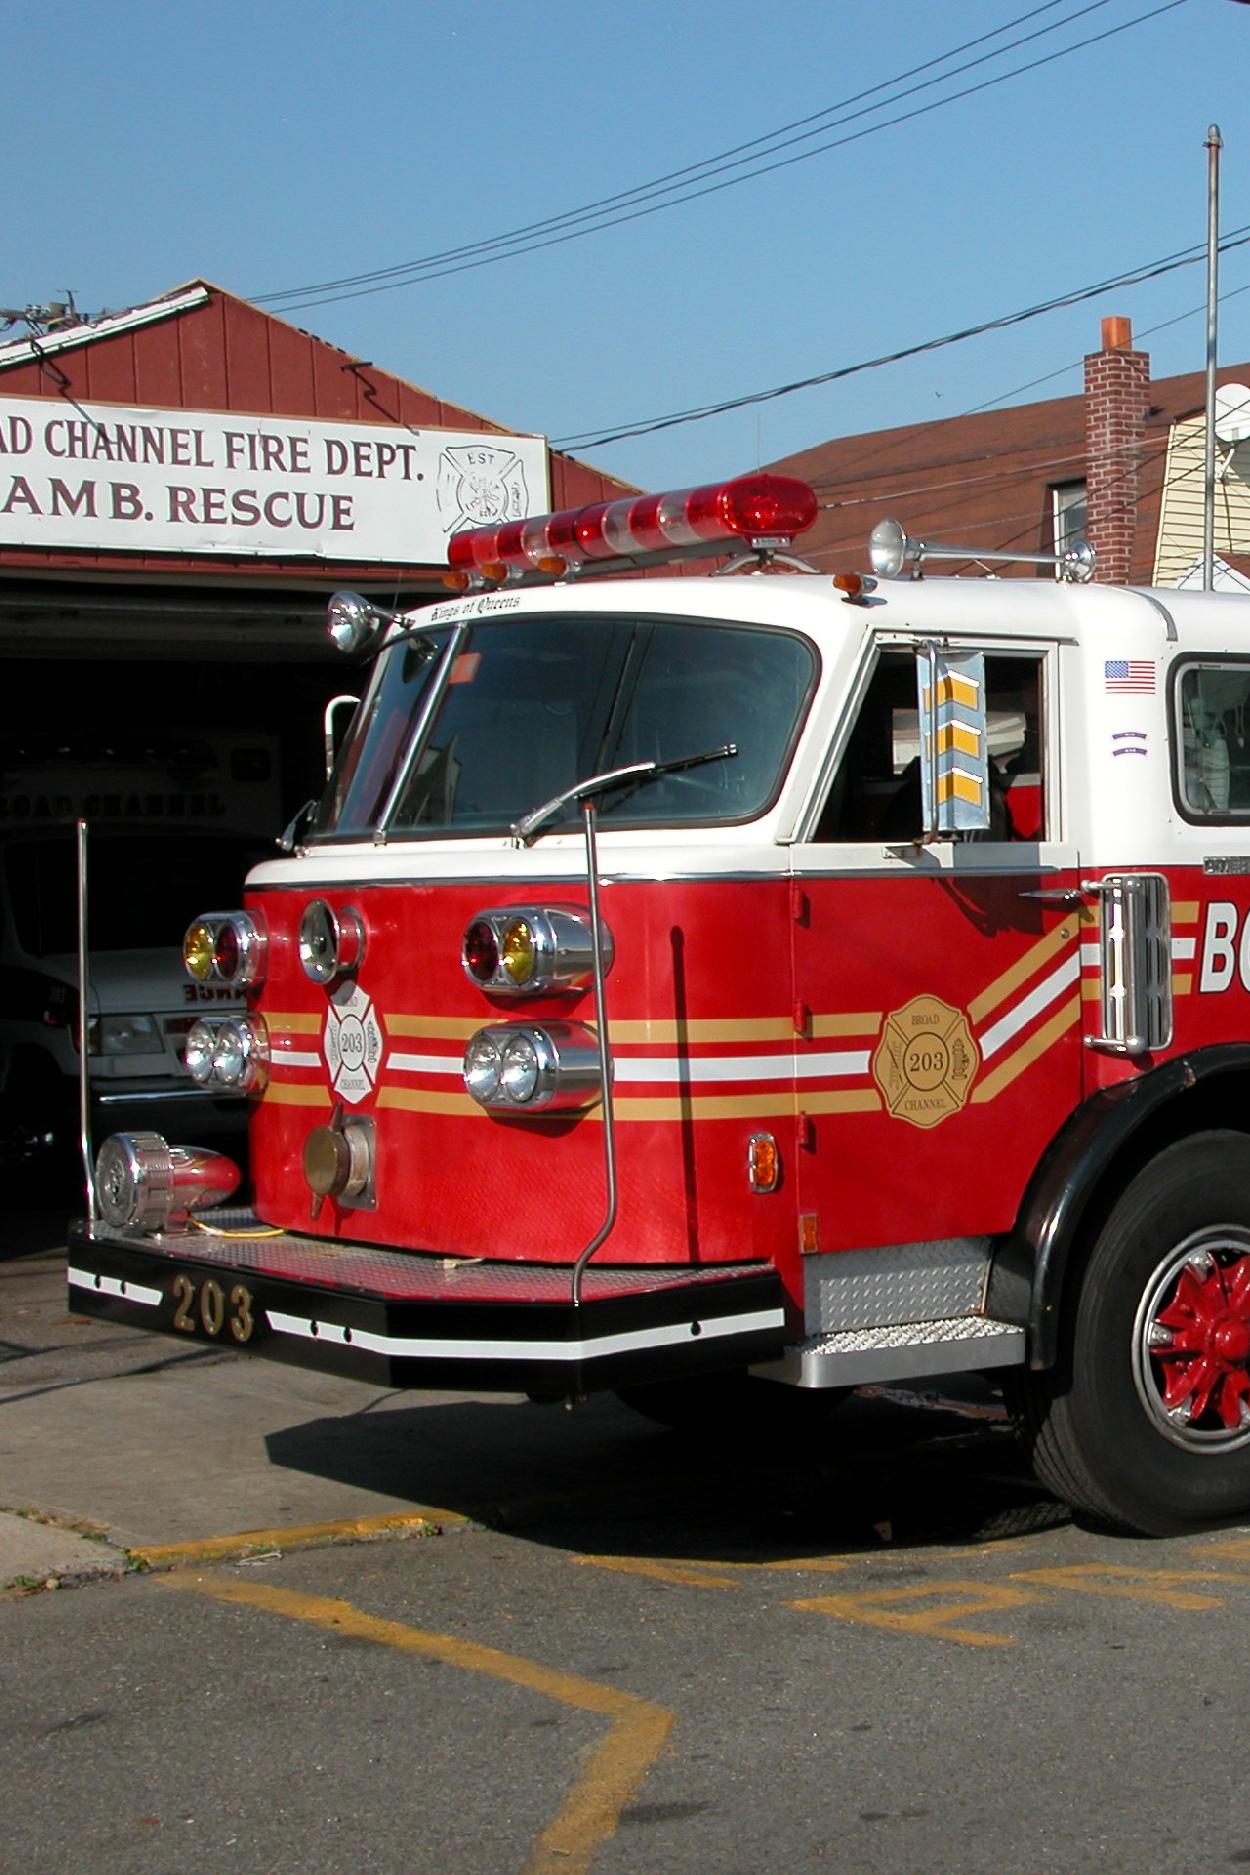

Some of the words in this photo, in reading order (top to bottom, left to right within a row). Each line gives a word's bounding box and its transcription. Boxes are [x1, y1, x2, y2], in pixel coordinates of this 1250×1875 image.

[45, 419, 214, 467] CHANNEL
[222, 430, 311, 473] FIRE
[323, 438, 424, 481] DEPT.
[165, 485, 354, 531] RESCUE
[911, 1014, 940, 1025] BROAD
[341, 1033, 363, 1053] 203
[909, 1052, 944, 1072] 203
[904, 1098, 946, 1111] CHANNEL
[172, 1274, 254, 1342] 203
